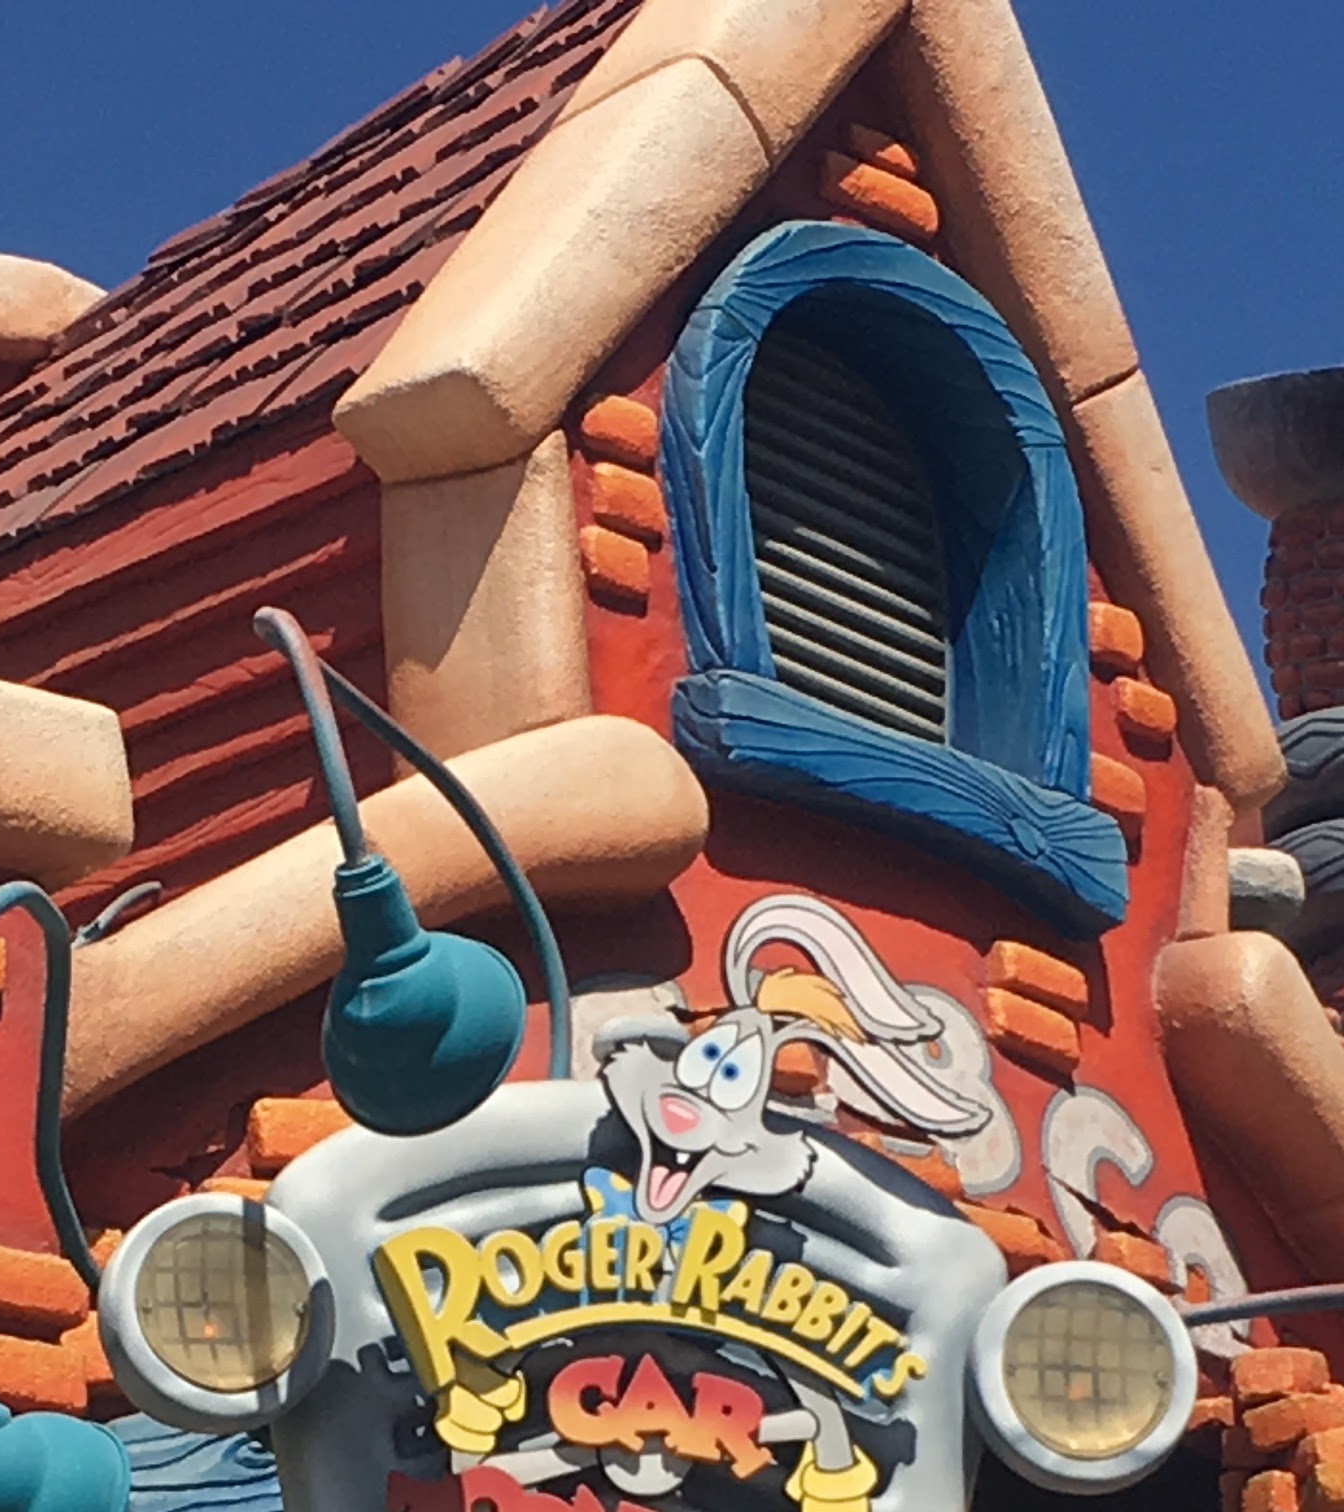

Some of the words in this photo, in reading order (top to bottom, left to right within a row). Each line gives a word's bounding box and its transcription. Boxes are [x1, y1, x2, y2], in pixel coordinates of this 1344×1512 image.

[373, 1218, 664, 1391] ROGER
[671, 1208, 928, 1397] RABBIT'S
[548, 1353, 773, 1479] CAR
